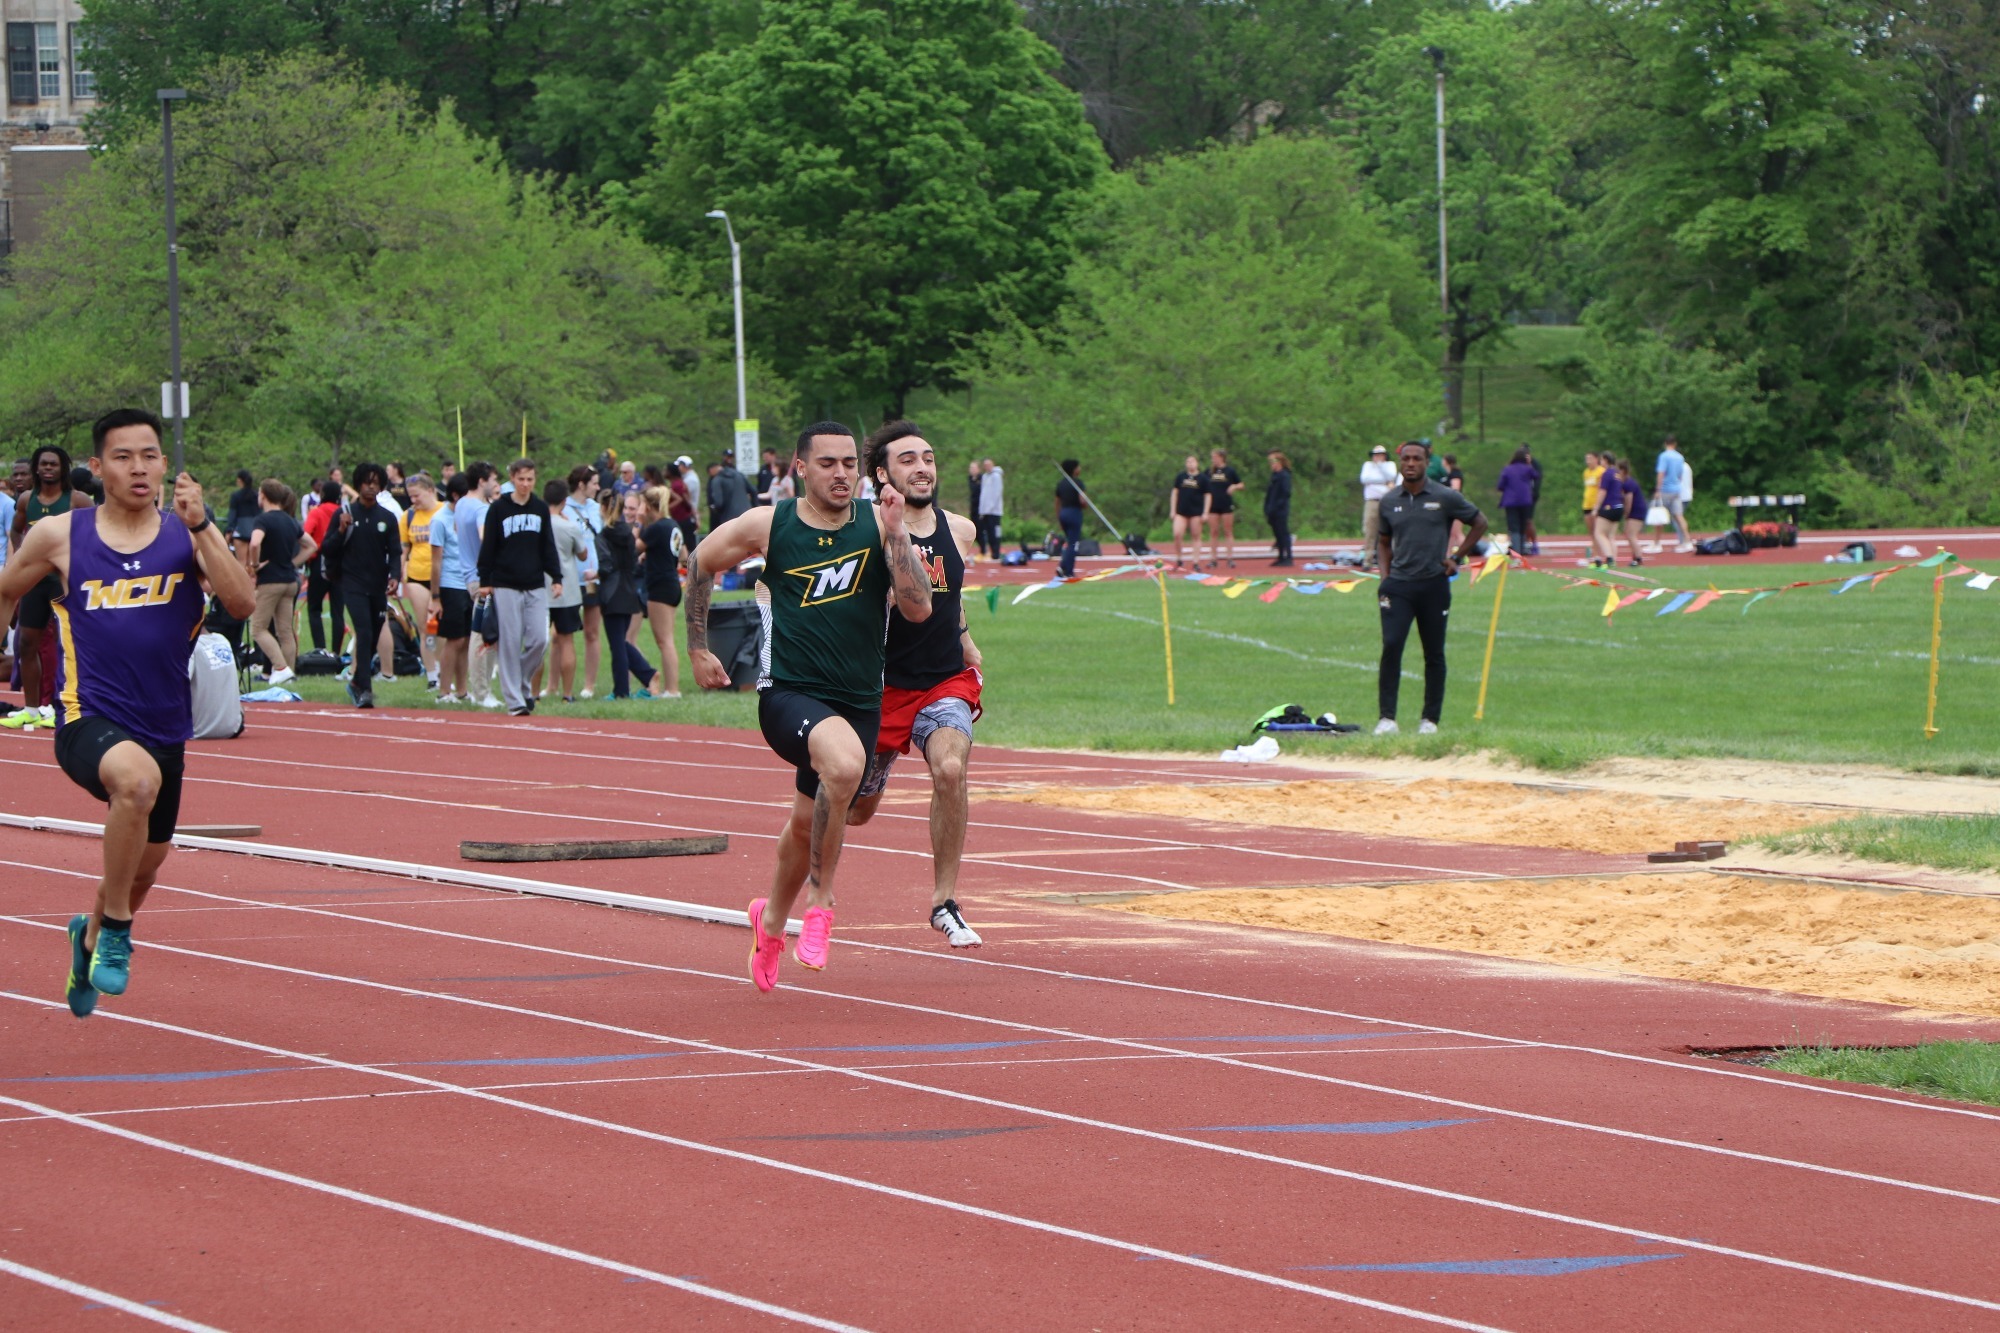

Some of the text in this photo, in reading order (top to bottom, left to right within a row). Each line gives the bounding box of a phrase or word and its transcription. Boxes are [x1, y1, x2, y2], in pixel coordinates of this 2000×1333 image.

[813, 559, 858, 597] M
[922, 556, 947, 587] M
[81, 573, 184, 610] WCU
